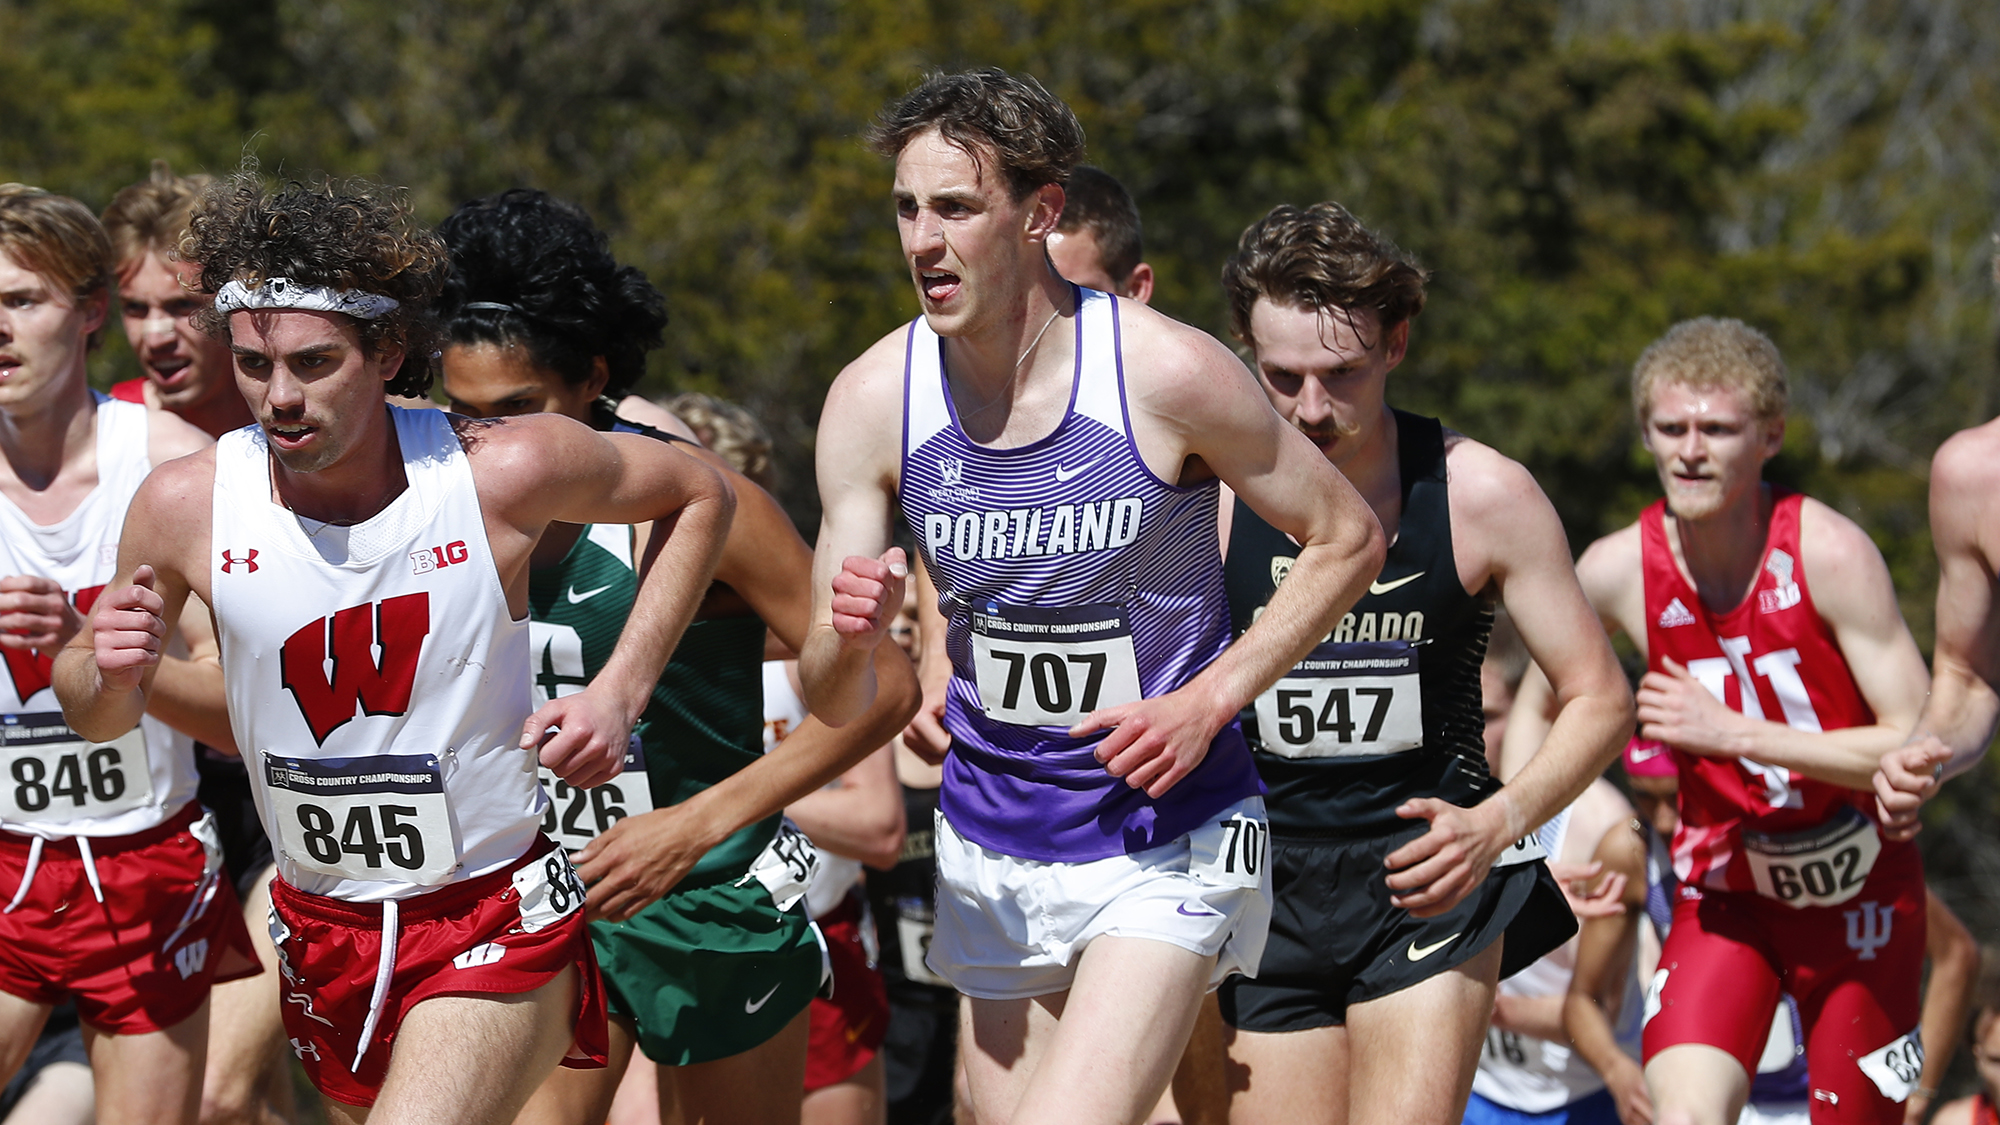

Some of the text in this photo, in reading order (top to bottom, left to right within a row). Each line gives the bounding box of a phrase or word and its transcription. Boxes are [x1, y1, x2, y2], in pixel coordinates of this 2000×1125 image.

[924, 497, 1144, 567] PORTLAND
[987, 618, 1121, 634] CROSS COUNTRY CHAMPIONSHIPS
[279, 591, 431, 749] W
[989, 649, 1108, 714] 707
[1304, 660, 1341, 671] COUNTRY
[1342, 658, 1410, 670] CHAMPIONSHIPS
[1276, 687, 1394, 746] 547
[10, 747, 126, 812] 846
[288, 773, 433, 787] CROSS COUNTRY CHAMPIONSHIPS
[296, 803, 426, 871] 845
[772, 826, 817, 883] 52
[1768, 846, 1868, 901] 602
[174, 938, 209, 981] W
[453, 942, 507, 971] W
